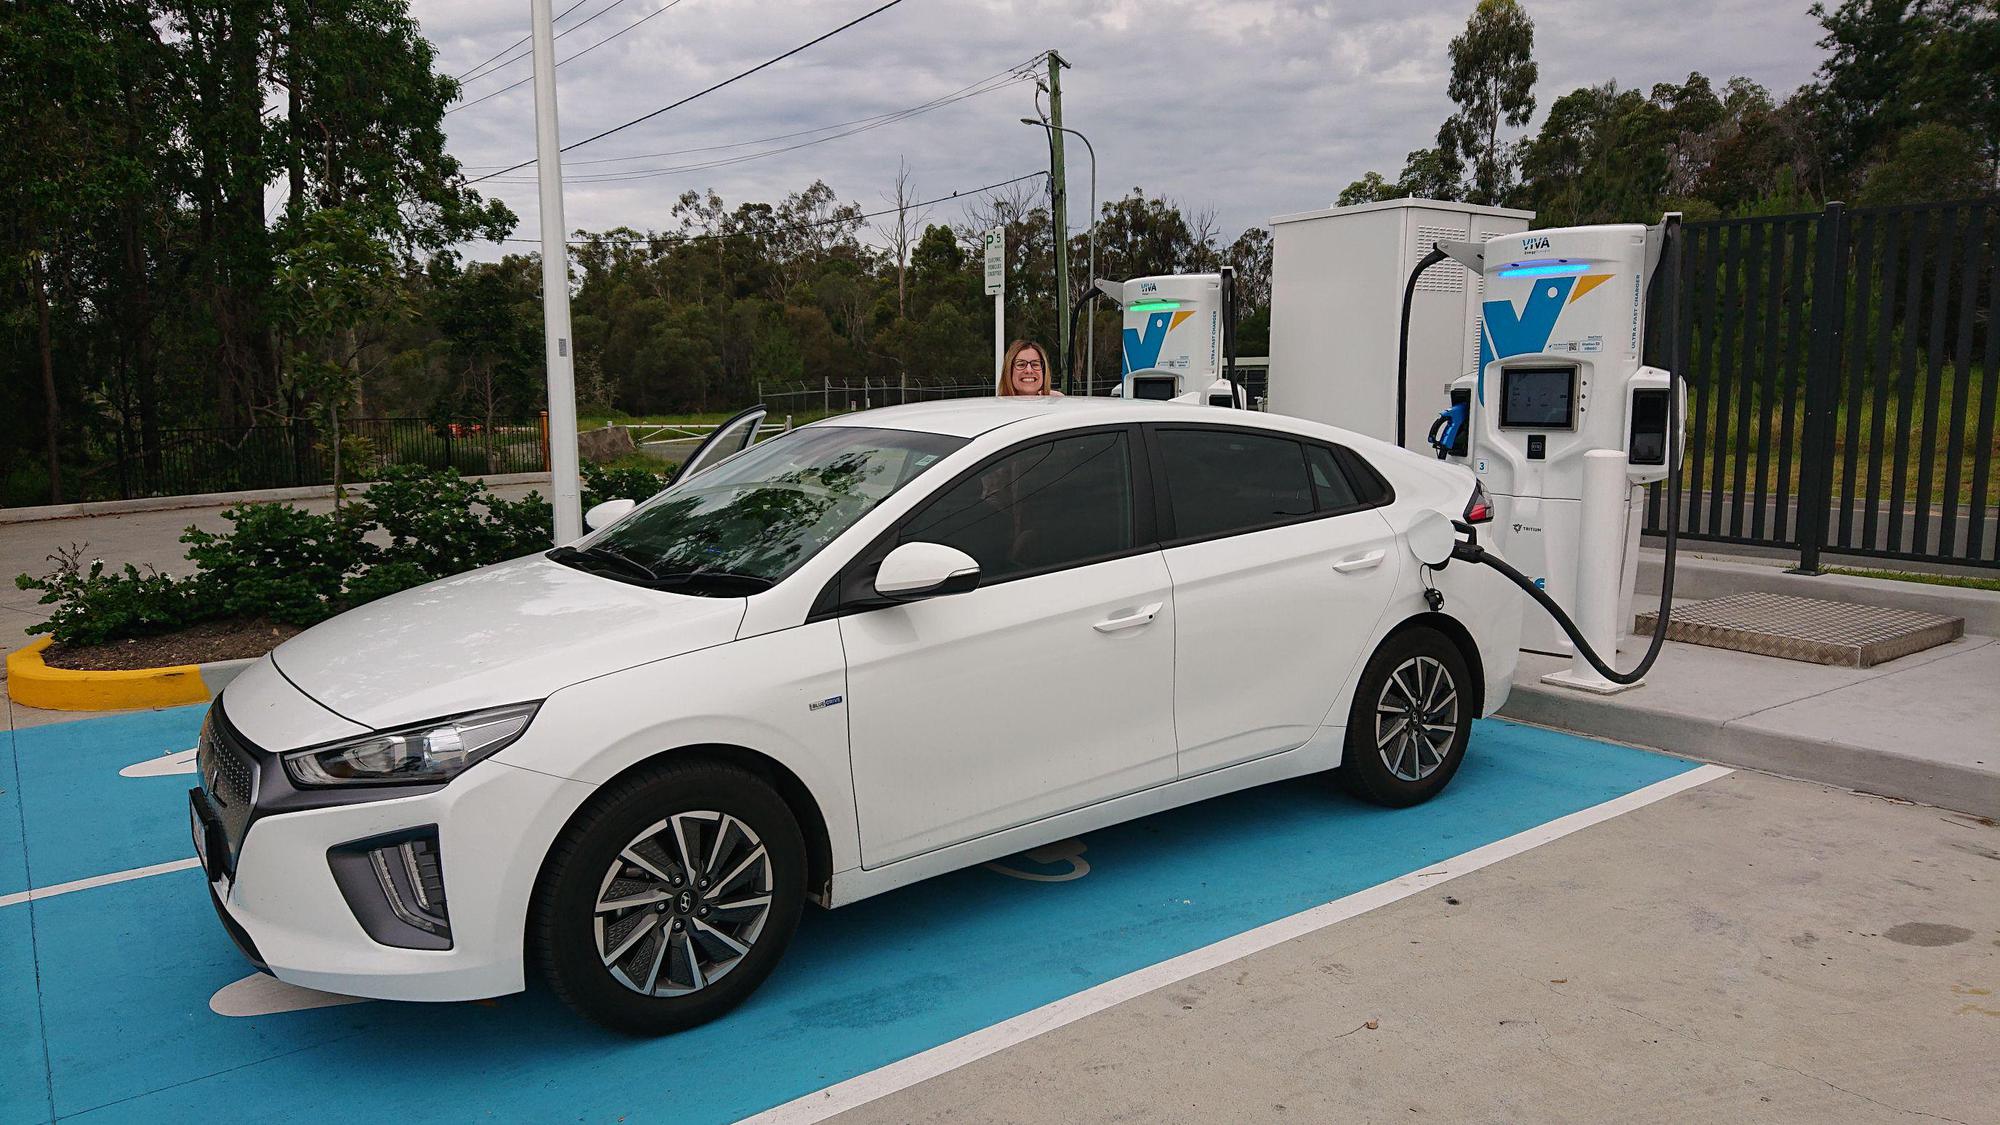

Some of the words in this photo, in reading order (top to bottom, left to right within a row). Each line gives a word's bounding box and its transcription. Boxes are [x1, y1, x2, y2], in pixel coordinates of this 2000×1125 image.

[986, 235, 994, 250] P
[997, 234, 1001, 243] 5
[1522, 237, 1550, 250] VIVA
[1140, 283, 1157, 292] VIVA
[1479, 462, 1485, 471] 3
